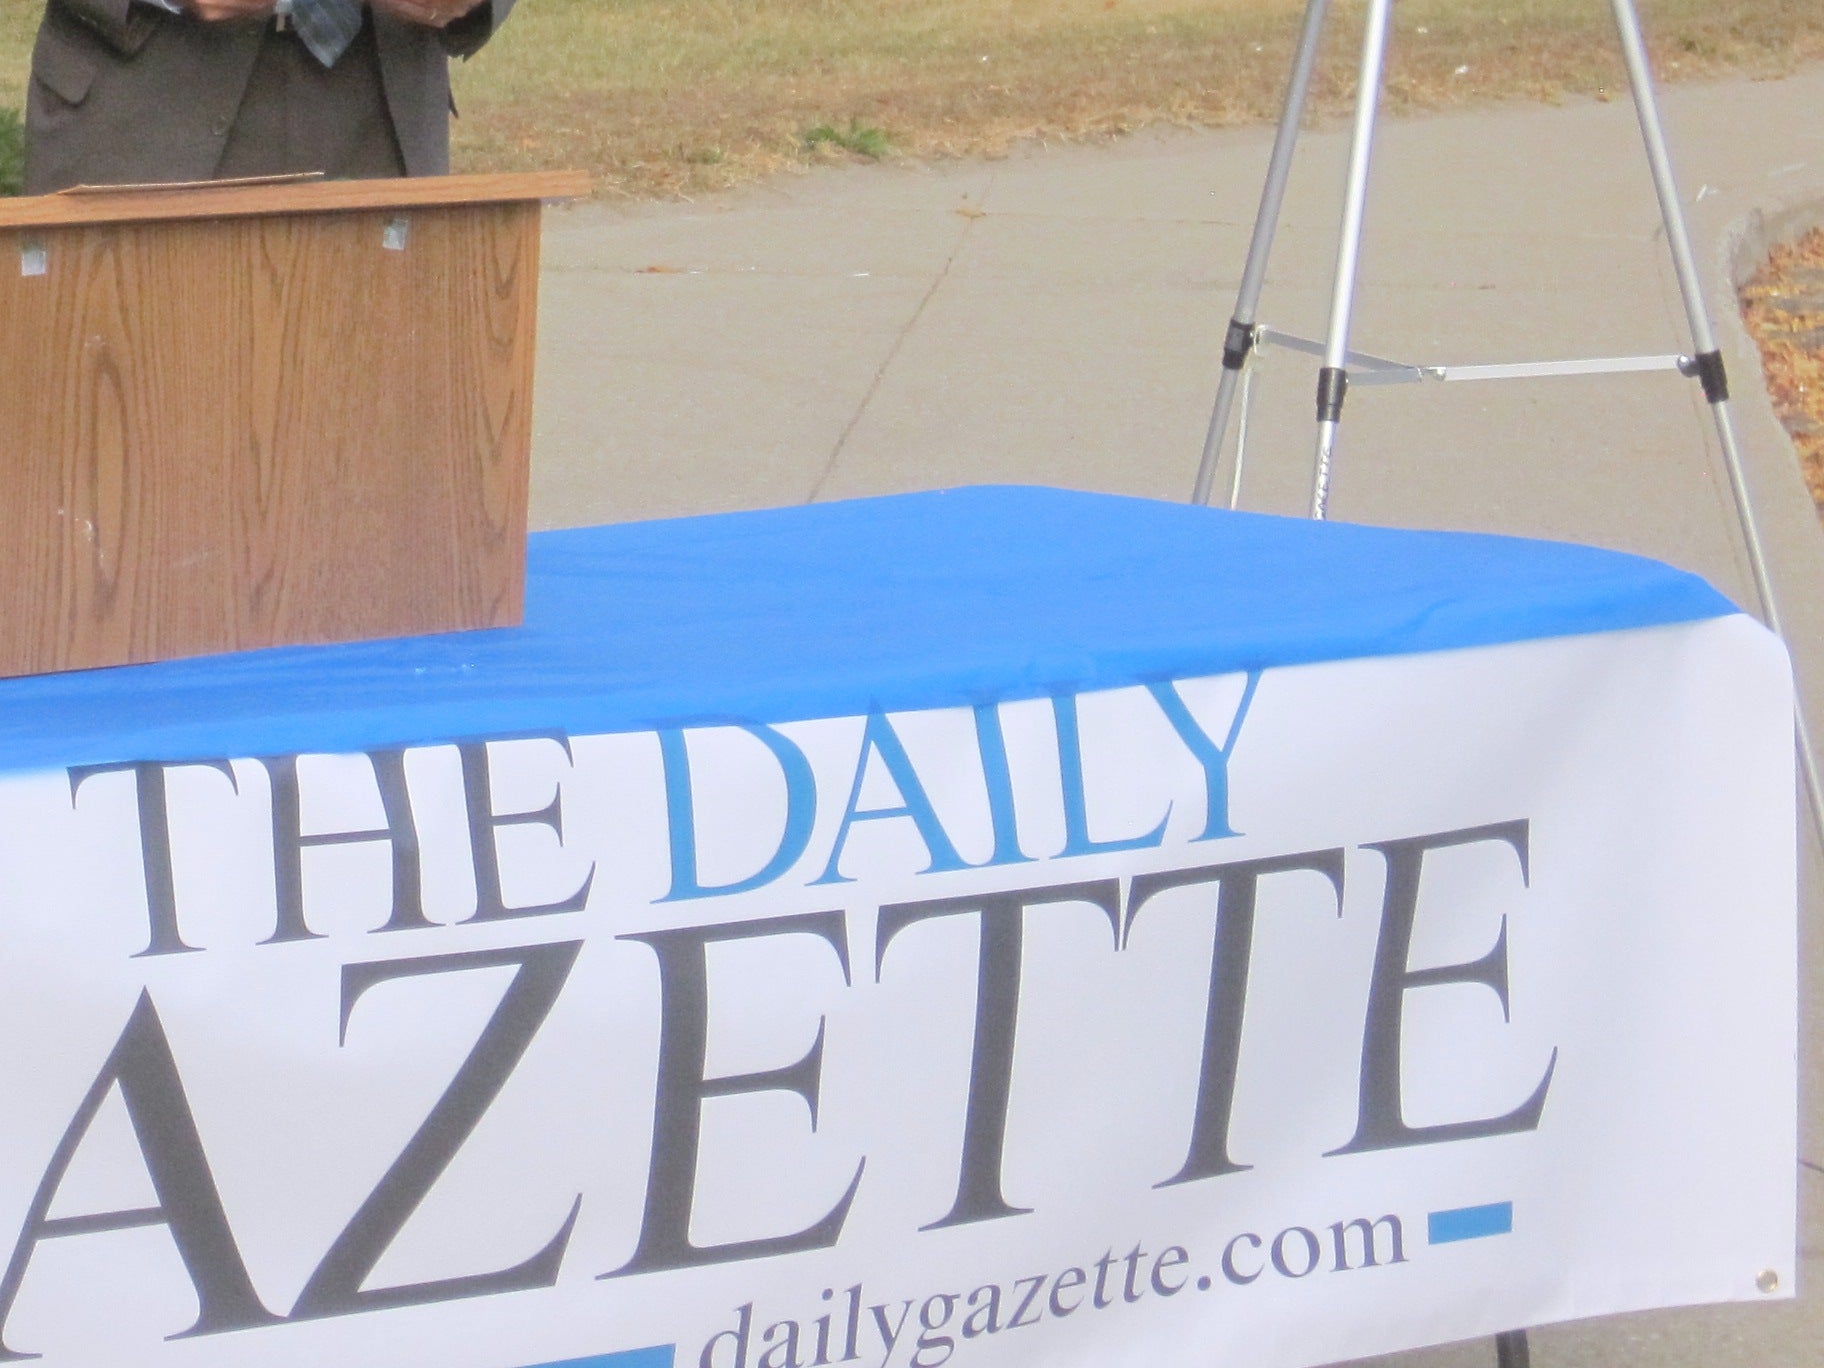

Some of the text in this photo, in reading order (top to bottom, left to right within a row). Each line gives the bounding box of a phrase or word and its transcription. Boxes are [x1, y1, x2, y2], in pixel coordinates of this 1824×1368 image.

[66, 668, 1265, 958] THE DAILY
[699, 1210, 1407, 1368] dailygazette.com
